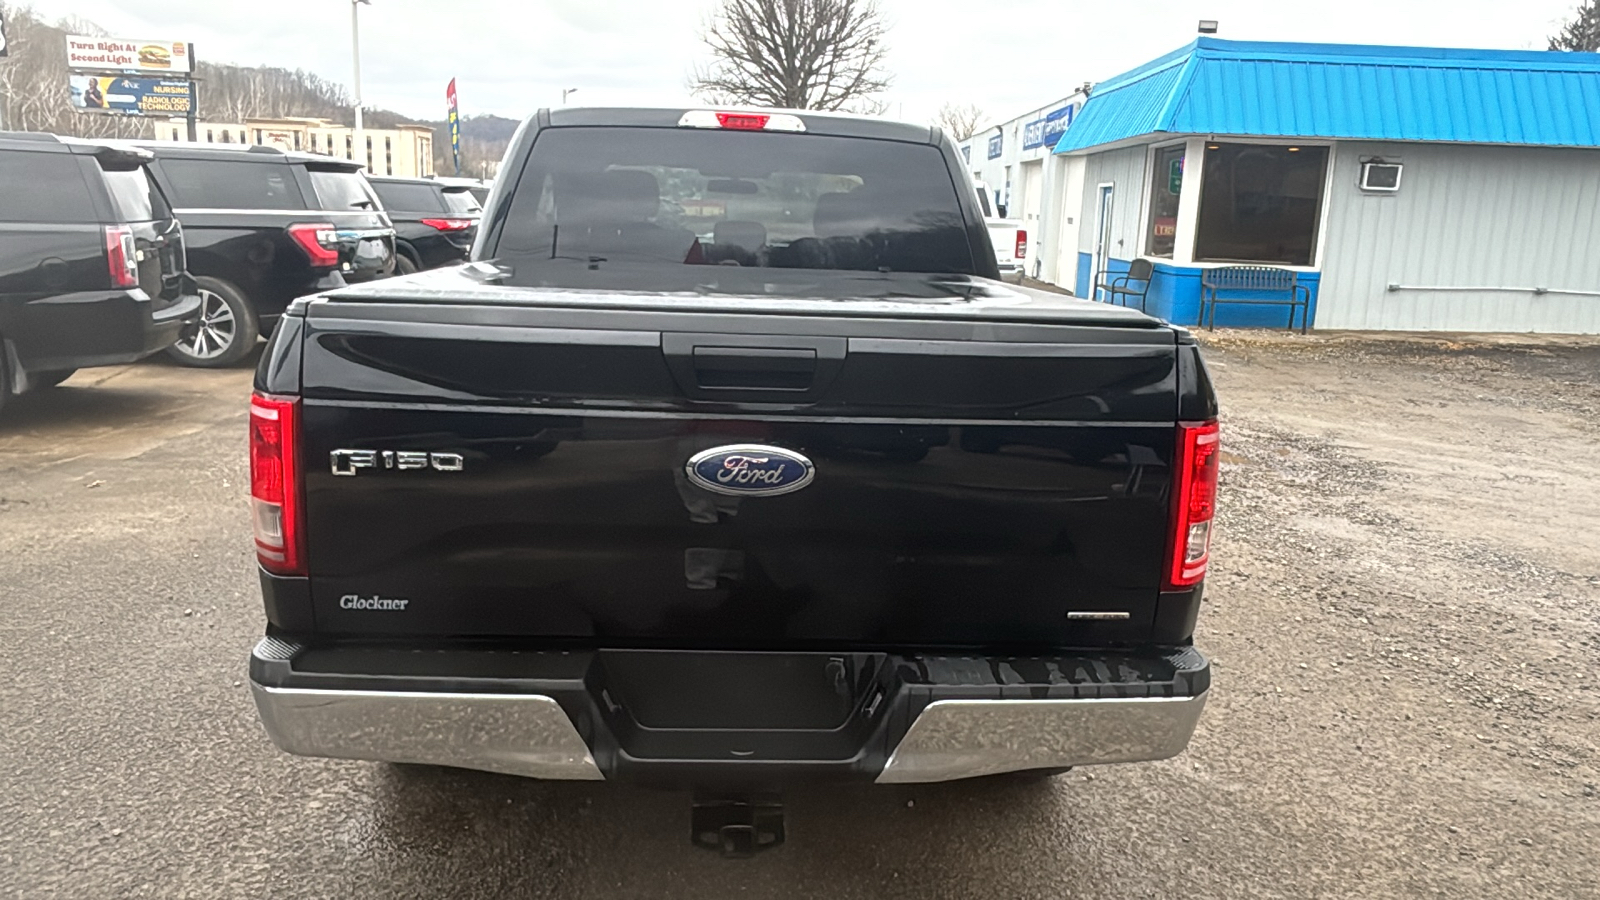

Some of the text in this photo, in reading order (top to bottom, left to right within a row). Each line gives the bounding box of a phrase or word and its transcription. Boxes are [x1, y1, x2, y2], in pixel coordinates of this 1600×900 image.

[70, 41, 136, 53] Turn Right At
[71, 53, 132, 65] Second Light
[154, 86, 190, 94] NURSING
[142, 96, 190, 104] RADIOLOGIC
[138, 102, 190, 111] TECHNOLOGY
[329, 448, 464, 476] F150
[716, 455, 786, 484] Ford
[339, 594, 409, 610] Glockner
